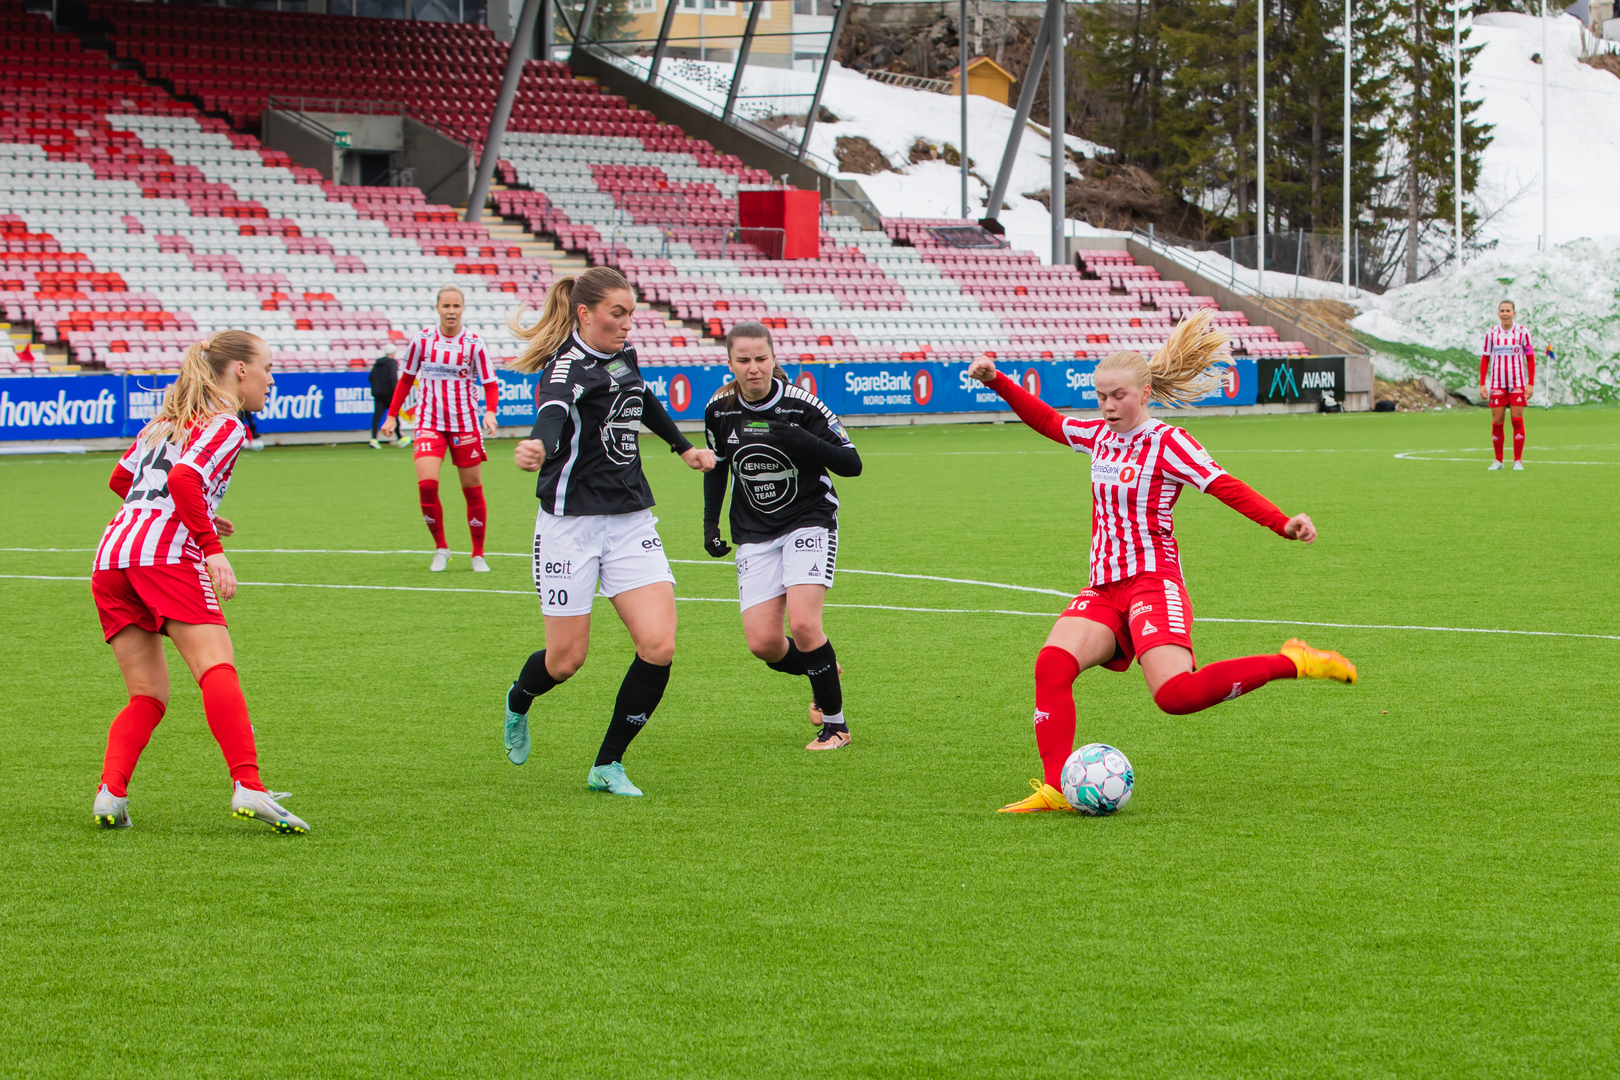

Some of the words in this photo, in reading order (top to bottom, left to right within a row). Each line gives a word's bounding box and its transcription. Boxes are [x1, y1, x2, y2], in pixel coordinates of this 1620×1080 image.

[845, 371, 911, 395] SpareBank
[1066, 368, 1096, 391] Spare
[1301, 371, 1335, 389] AVARN
[255, 384, 323, 420] skraft
[863, 394, 912, 405] NORD-NORGE
[0, 388, 117, 427] havskraft
[421, 442, 432, 452] 11
[621, 442, 637, 451] TEAM
[743, 462, 779, 471] JENSEN
[754, 482, 776, 493] BYGG
[755, 491, 777, 500] TEAM
[795, 535, 823, 549] ecit
[545, 559, 572, 575] ecit
[548, 589, 569, 606] 20
[1068, 599, 1090, 611] 16
